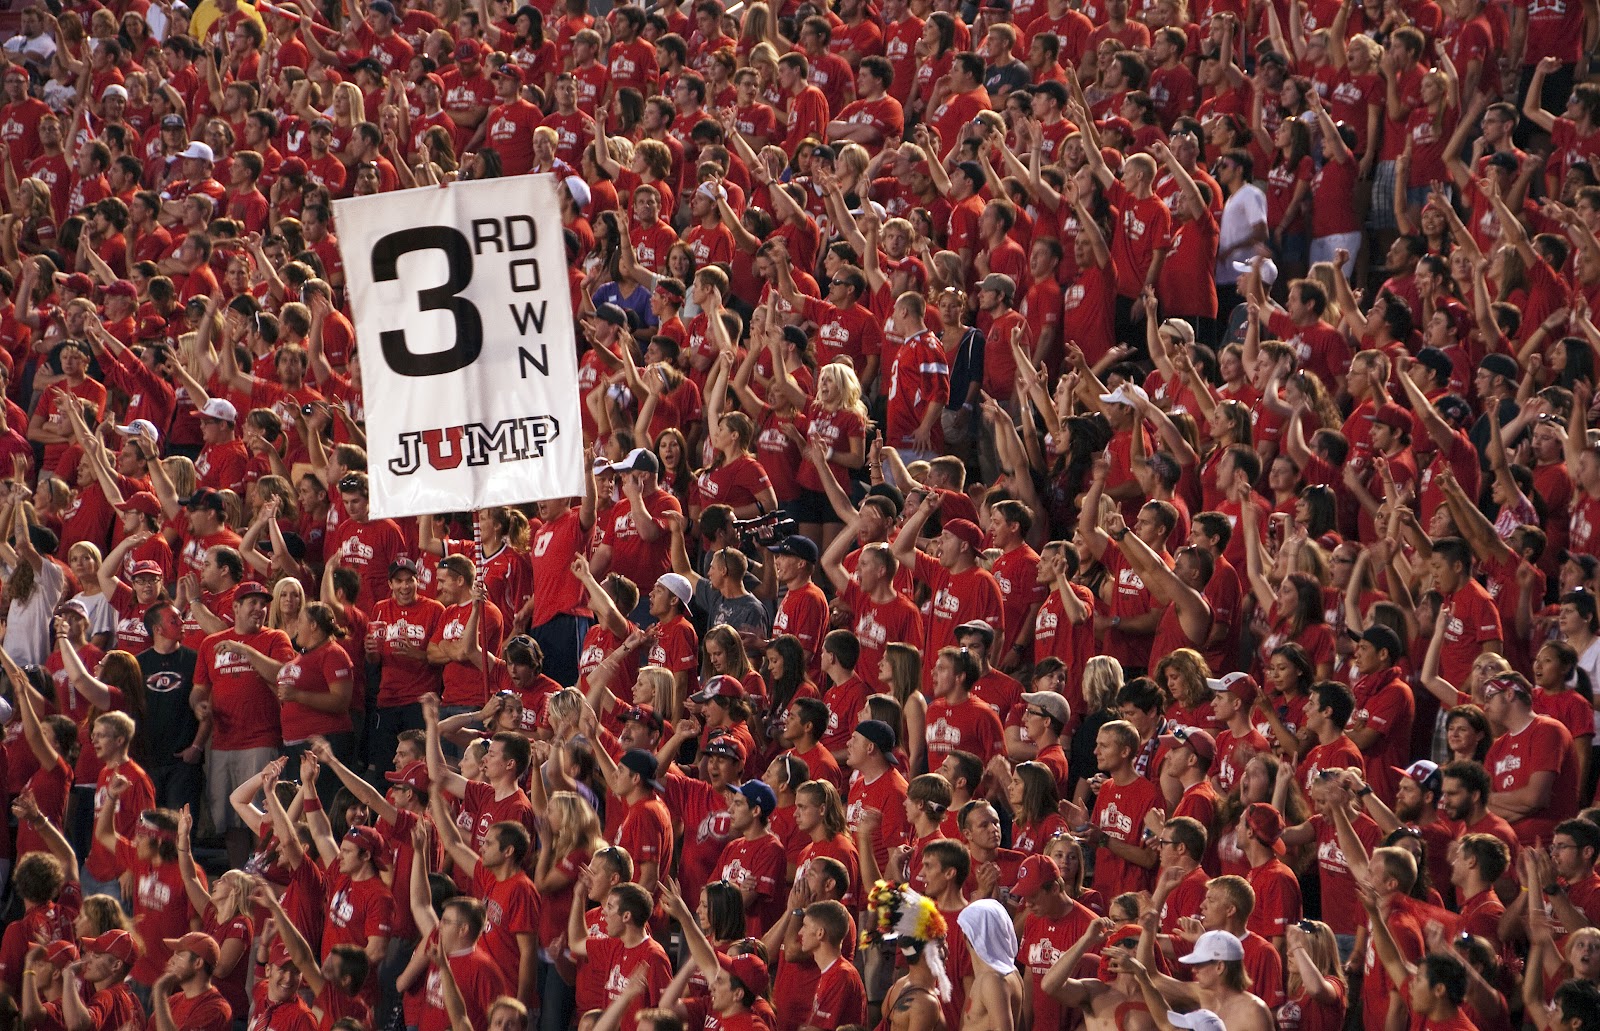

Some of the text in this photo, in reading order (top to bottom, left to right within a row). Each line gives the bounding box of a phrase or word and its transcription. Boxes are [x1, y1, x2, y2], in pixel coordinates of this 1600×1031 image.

[557, 129, 578, 144] SS
[388, 414, 560, 477] JUMP
[1099, 809, 1133, 834] MUSS
